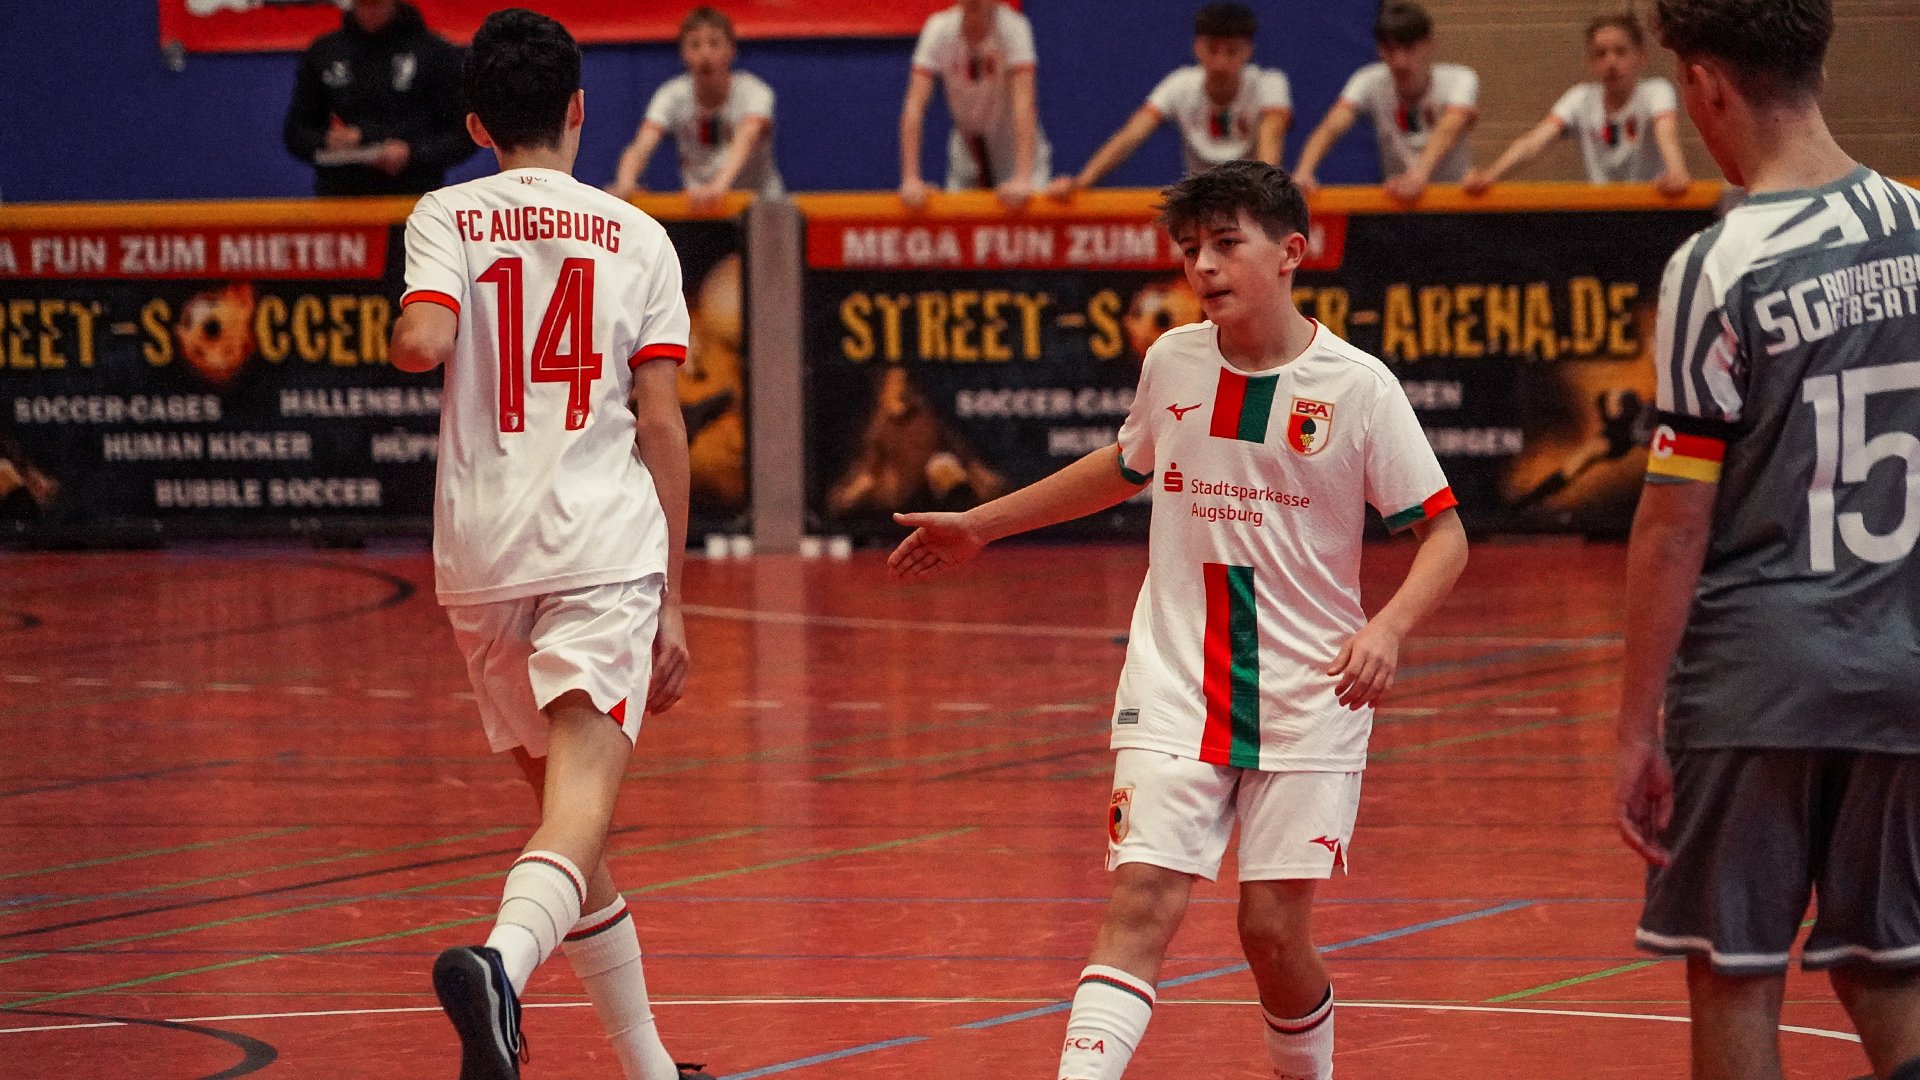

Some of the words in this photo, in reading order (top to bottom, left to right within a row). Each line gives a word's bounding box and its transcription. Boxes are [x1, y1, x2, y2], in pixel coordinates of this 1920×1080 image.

[520, 176, 547, 185] 19
[456, 210, 483, 241] FC
[490, 206, 621, 253] AUGSBURG
[31, 236, 107, 273] FUN
[121, 234, 205, 272] ZUM
[219, 233, 366, 270] MIETEN
[843, 228, 960, 266] MEGA
[974, 227, 1054, 264] FUN
[1066, 226, 1158, 264] ZUM
[1755, 278, 1835, 355] SG
[475, 257, 603, 432] 14
[15, 394, 221, 423] SOCCER-CAGES
[1296, 401, 1328, 417] FCA
[104, 432, 201, 460] HUMAN
[209, 431, 312, 461] KICKER
[1652, 424, 1676, 458] C
[1803, 362, 1920, 572] 15
[155, 479, 261, 507] BUBBLE
[269, 478, 382, 507] SOCCER
[1191, 479, 1310, 508] Stadtsparkasse
[1191, 502, 1263, 527] Augsburg
[1065, 1038, 1105, 1054] FCA
